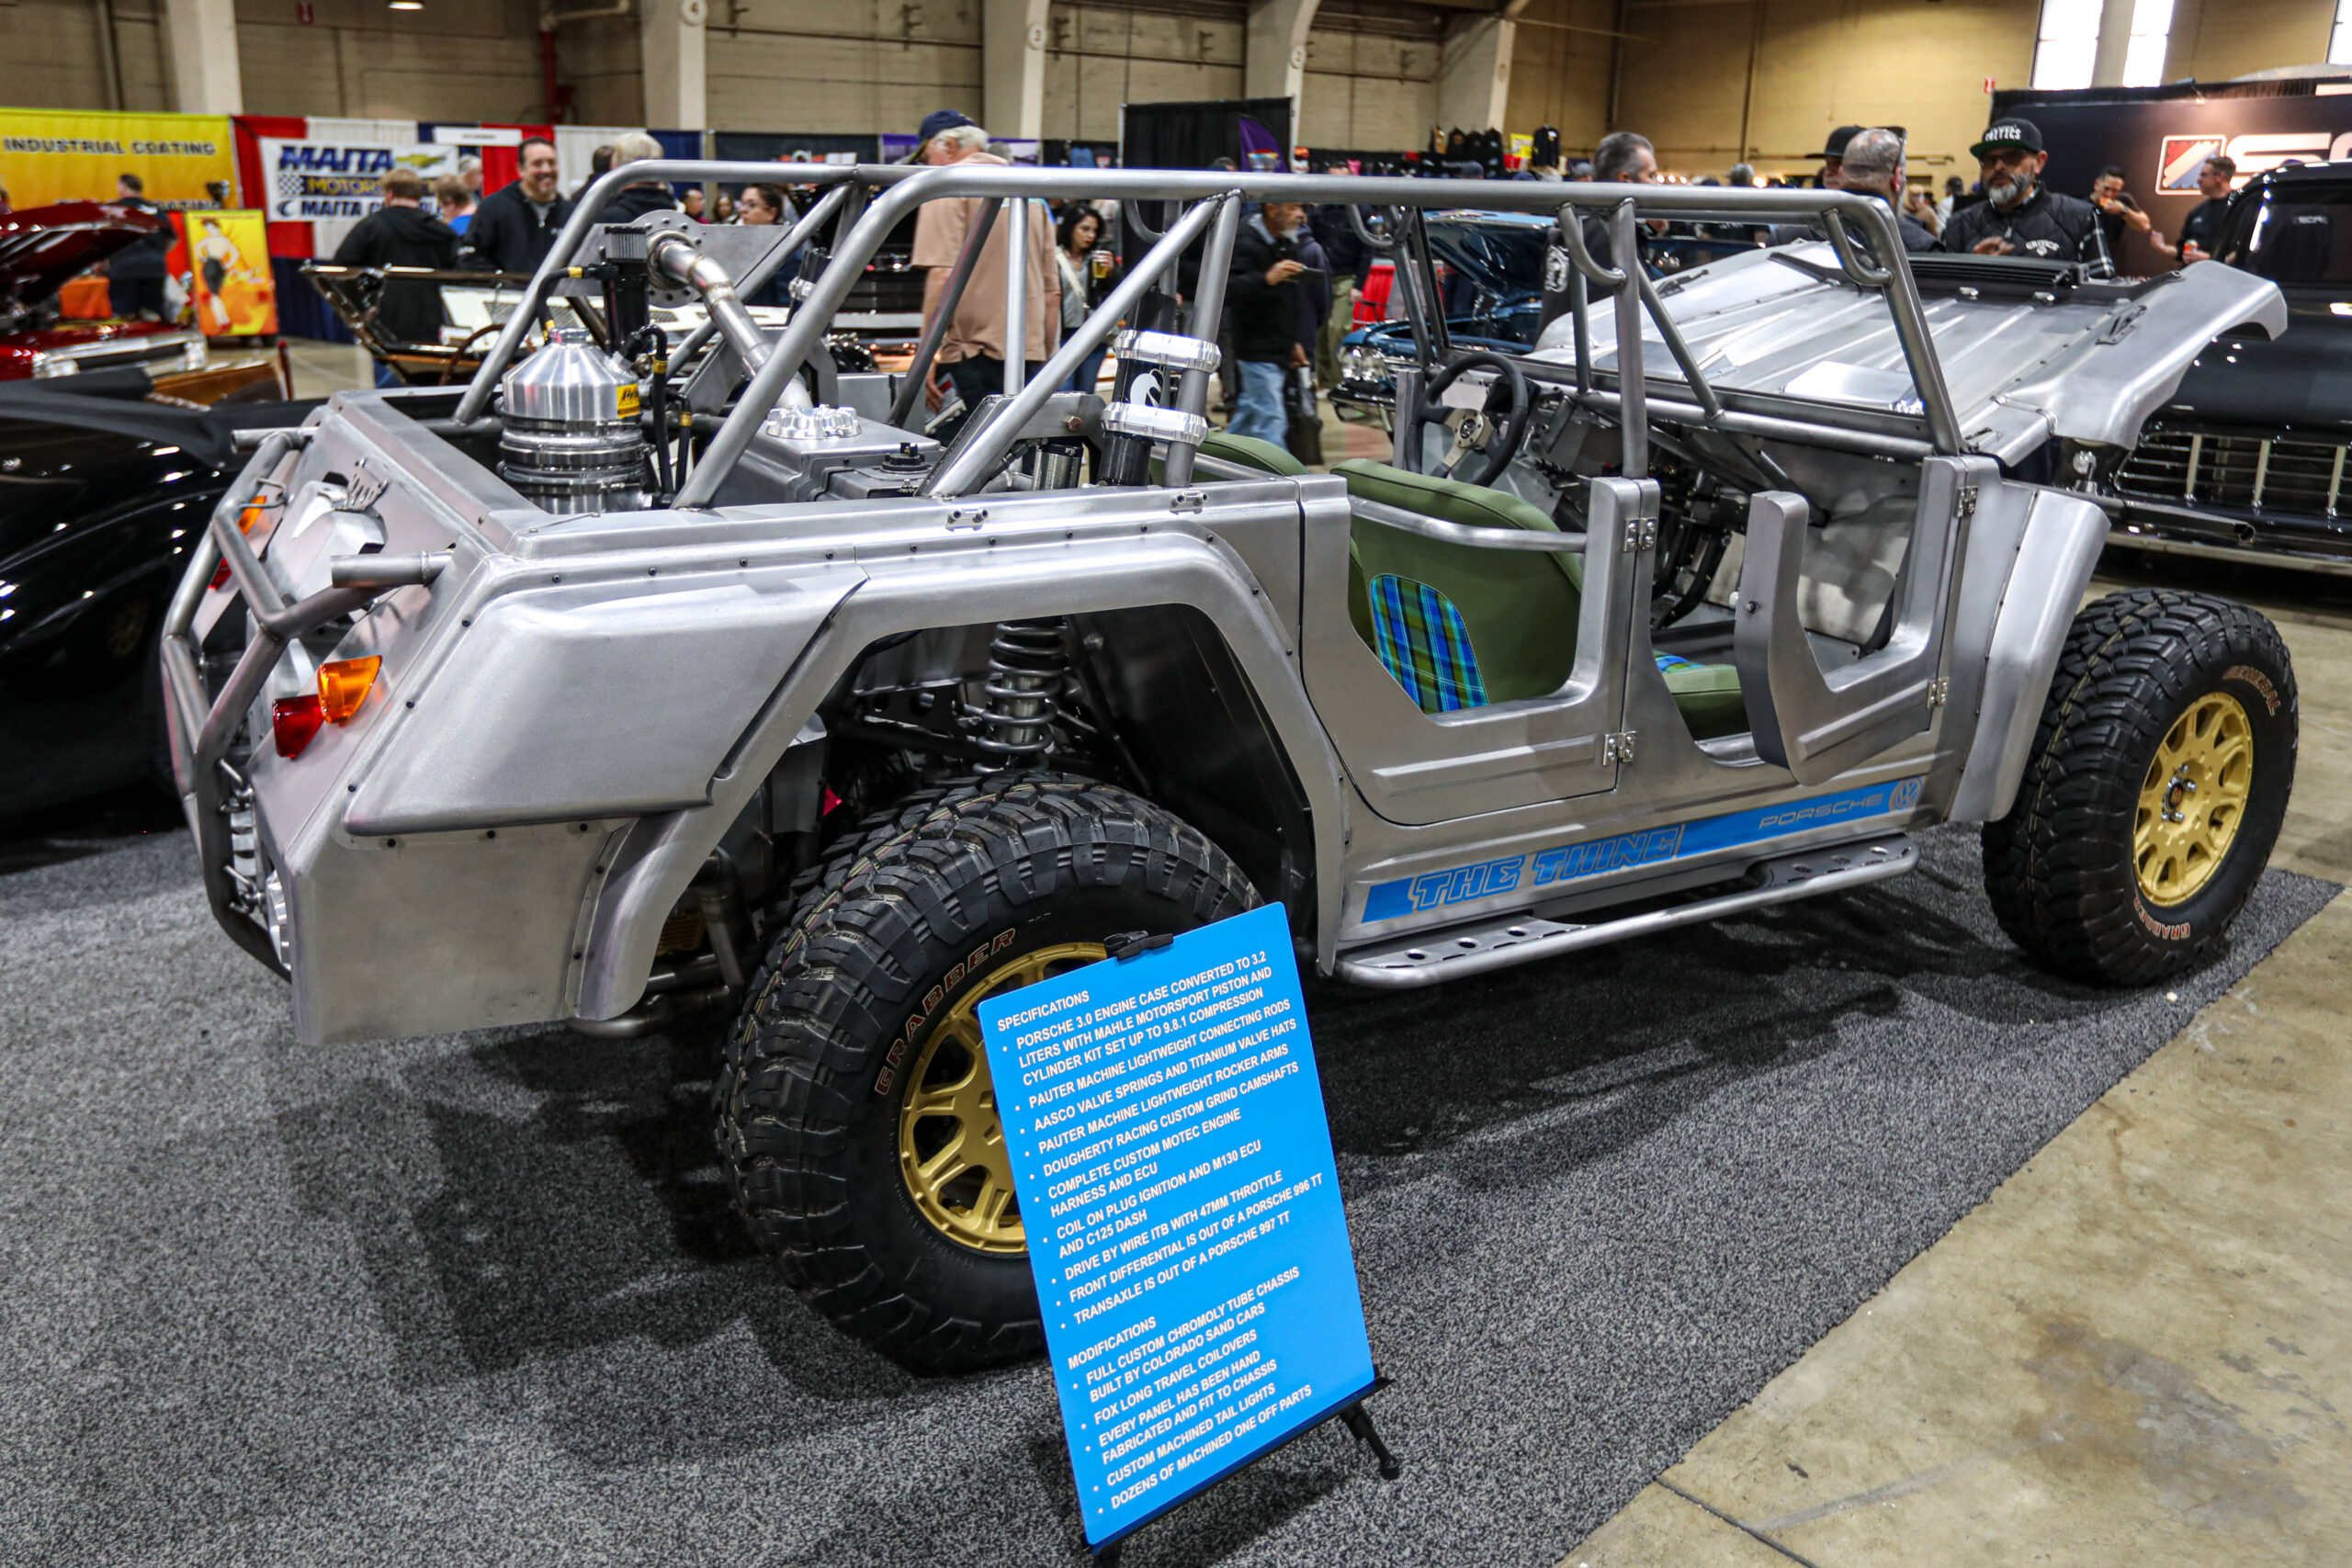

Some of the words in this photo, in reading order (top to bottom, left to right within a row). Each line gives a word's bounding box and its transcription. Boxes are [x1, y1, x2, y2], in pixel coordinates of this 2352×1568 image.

[4, 137, 126, 154] INDUSTRIAL
[130, 141, 217, 155] COATING
[278, 145, 394, 173] MAITA
[301, 200, 362, 217] MAITA
[1758, 792, 1885, 829] PORSCHE
[1411, 854, 1525, 911] THE
[1533, 824, 1682, 885] THING
[875, 928, 1016, 1096] GRABBER
[997, 990, 1091, 1032] SPECIFICATIONS
[1016, 1019, 1075, 1050] PORSCHE
[1076, 1012, 1093, 1029] 3.0
[1093, 996, 1138, 1022] ENGINE
[1138, 985, 1170, 1006] CASE
[1170, 962, 1235, 995] CONVERTED
[1235, 956, 1250, 971] TO
[1251, 951, 1267, 965] 3.2
[1018, 1043, 1062, 1068] LITERS
[1061, 1031, 1093, 1052] WITH
[1093, 1016, 1135, 1041] MAHLE
[1135, 987, 1210, 1026] MOTORSPORT
[1211, 974, 1250, 998] PISTON
[1250, 966, 1272, 984] AND
[1023, 1055, 1083, 1087] CYLINDER
[1083, 1045, 1102, 1064] KIT
[1104, 1037, 1126, 1055] SET
[1128, 1031, 1145, 1046] UP
[1145, 1024, 1162, 1040] TO
[1162, 1015, 1187, 1034] 9.8.1
[1188, 987, 1264, 1024] COMPRESSION
[1028, 1081, 1076, 1109] PAUTER
[1076, 1061, 1127, 1090] MACHINE
[1126, 1033, 1197, 1071] LIGHTWEIGHT
[1199, 1010, 1263, 1043] CONNECTING
[1262, 998, 1291, 1019] RODS
[1035, 1105, 1076, 1133] AASCO
[1076, 1089, 1114, 1114] VALVE
[1114, 1070, 1164, 1100] SPRINGS
[1165, 1061, 1188, 1080] AND
[1188, 1041, 1238, 1069] TITANIUM
[1237, 1028, 1271, 1050] VALVE
[1270, 1018, 1297, 1038] HATS
[1038, 1125, 1087, 1155] PAUTER
[1087, 1103, 1140, 1134] MACHINE
[1140, 1073, 1214, 1113] LIGHTWEIGHT
[1215, 1055, 1260, 1083] ROCKER
[1260, 1043, 1289, 1065] ARMS
[1043, 1136, 1114, 1178] DOUGHERTY
[1115, 1119, 1159, 1147] RACING
[1159, 1100, 1205, 1128] CUSTOM
[1205, 1086, 1238, 1109] GRIND
[1238, 1061, 1299, 1095] CAMSHAFTS
[1047, 1162, 1113, 1199] COMPLETE
[1113, 1142, 1161, 1171] CUSTOM
[1161, 1125, 1201, 1151] MOTEC
[1201, 1107, 1242, 1134] ENGINE
[1050, 1184, 1107, 1218] HARNESS
[1108, 1173, 1133, 1193] AND
[1134, 1161, 1159, 1182] ECU
[1057, 1219, 1086, 1240] COIL
[1086, 1209, 1105, 1226] ON
[1105, 1194, 1138, 1218] PLUG
[1138, 1172, 1187, 1203] IGNITION
[1188, 1162, 1212, 1182] AND
[1212, 1149, 1239, 1170] M130
[1238, 1139, 1261, 1158] ECU
[1059, 1237, 1085, 1259] AND
[1086, 1224, 1114, 1246] C125
[1114, 1208, 1148, 1233] DASH
[1064, 1254, 1102, 1280] DRIVE
[1102, 1245, 1118, 1263] BY
[1119, 1231, 1150, 1255] WIRE
[1150, 1223, 1170, 1241] ITB
[1170, 1209, 1199, 1231] WITH
[1200, 1194, 1229, 1217] 47MM
[1229, 1169, 1283, 1203] THROTTLE
[1069, 1274, 1107, 1303] FRONT
[1109, 1239, 1186, 1284] DIFFERENTIAL
[1185, 1233, 1198, 1247] IS
[1198, 1221, 1220, 1241] OUT
[1221, 1213, 1236, 1230] OF
[1237, 1211, 1247, 1224] A
[1245, 1187, 1294, 1219] PORSCHE
[1293, 1179, 1310, 1197] 996
[1309, 1172, 1323, 1187] TT
[1073, 1282, 1144, 1325] TRANSAXLE
[1144, 1276, 1157, 1292] IS
[1157, 1263, 1180, 1284] OUT
[1182, 1256, 1197, 1272] OF
[1199, 1252, 1208, 1265] A
[1207, 1226, 1259, 1260] PORSCHE
[1259, 1217, 1276, 1235] 997
[1276, 1210, 1290, 1225] TT
[1068, 1315, 1157, 1371] MODIFICATIONS
[1086, 1361, 1117, 1385] FULL
[1117, 1335, 1166, 1369] CUSTOM
[1167, 1303, 1226, 1343] CHROMOLY
[1226, 1288, 1256, 1312] TUBE
[1256, 1266, 1300, 1297] CHASSIS
[1089, 1375, 1123, 1403] BUILT
[1124, 1366, 1140, 1385] BY
[1142, 1334, 1204, 1375] COLORADO
[1204, 1318, 1236, 1342] SAND
[1236, 1302, 1266, 1325] CARS
[1093, 1402, 1120, 1426] FOX
[1119, 1384, 1154, 1412] LONG
[1153, 1362, 1197, 1393] TRAVEL
[1197, 1328, 1258, 1370] COILOVERS
[1098, 1416, 1136, 1448] EVERY
[1137, 1398, 1176, 1426] PANEL
[1175, 1383, 1200, 1405] HAS
[1200, 1366, 1230, 1392] BEEN
[1230, 1350, 1261, 1375] HAND
[1102, 1417, 1173, 1465] FABRICATED
[1174, 1404, 1198, 1426] AND
[1198, 1392, 1215, 1412] FIT
[1216, 1384, 1232, 1401] TO
[1232, 1359, 1278, 1392] CHASSIS
[1106, 1450, 1156, 1486] CUSTOM
[1156, 1417, 1215, 1459] MACHINED
[1214, 1405, 1238, 1425] TAIL
[1238, 1382, 1276, 1412] LIGHTS
[1111, 1473, 1159, 1509] DOZENS
[1159, 1462, 1175, 1481] OF
[1176, 1430, 1234, 1472] MACHINED
[1234, 1416, 1258, 1438] ONE
[1257, 1403, 1278, 1424] OFF
[1279, 1384, 1312, 1412] PARTS
